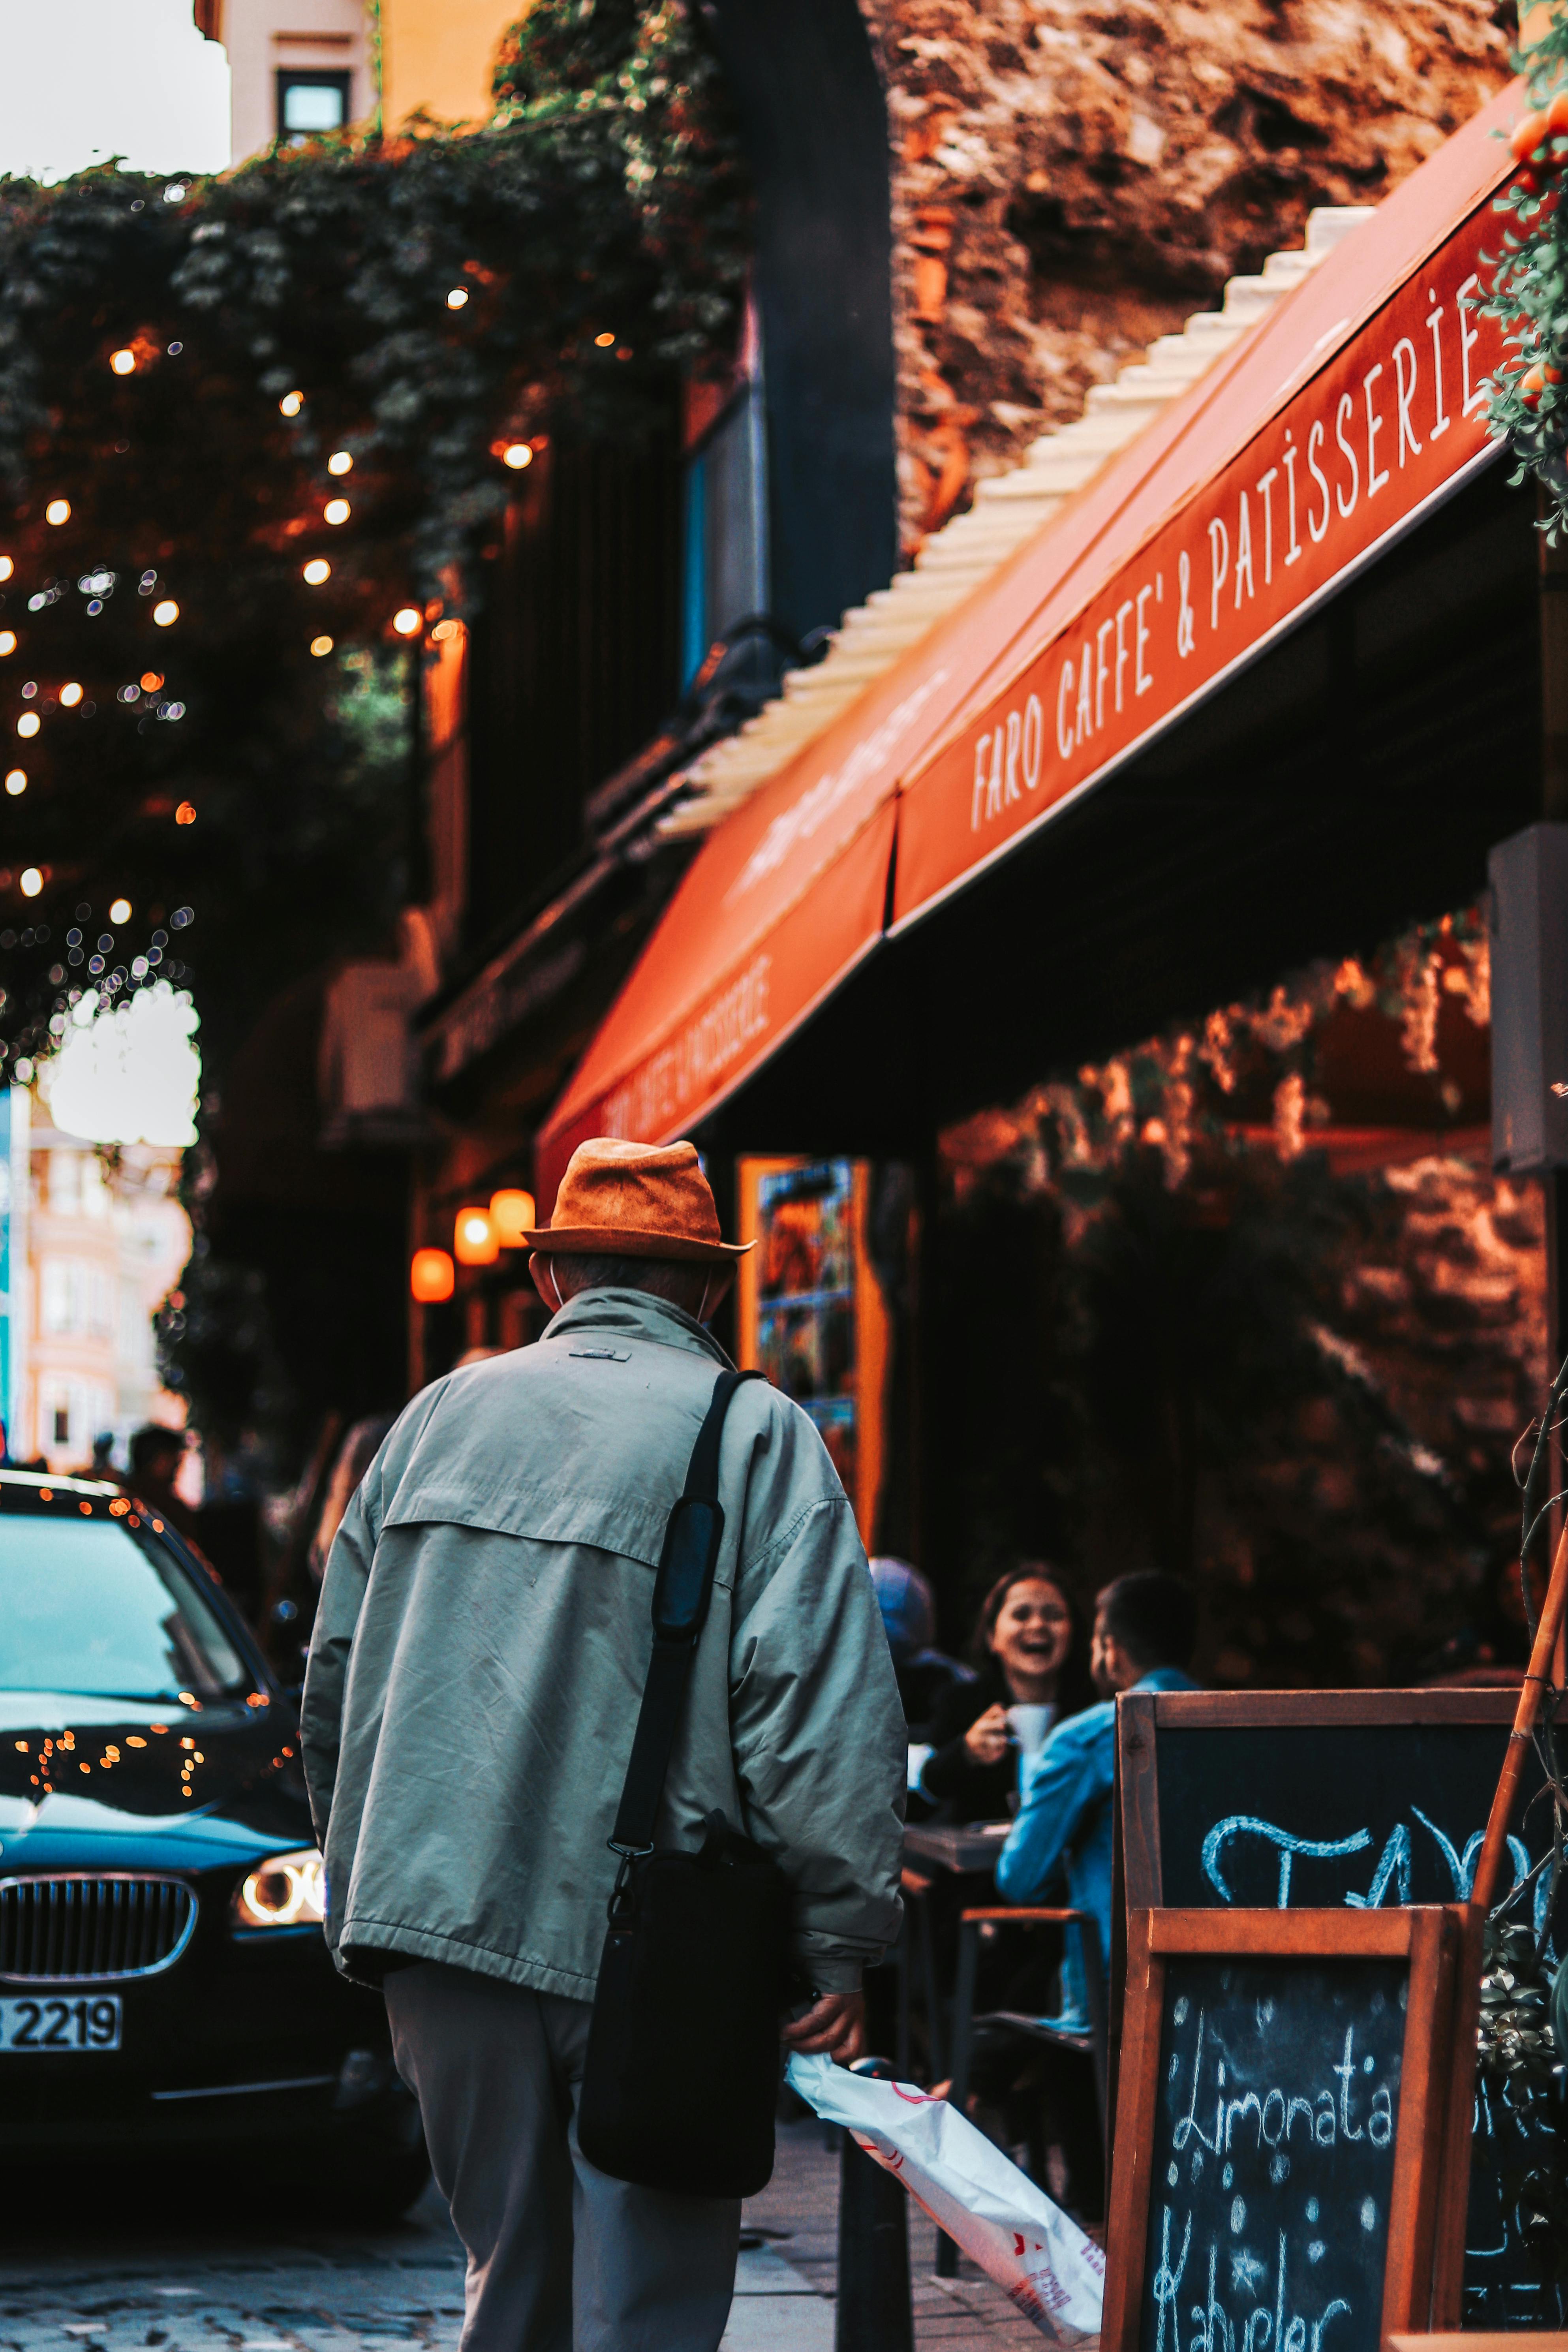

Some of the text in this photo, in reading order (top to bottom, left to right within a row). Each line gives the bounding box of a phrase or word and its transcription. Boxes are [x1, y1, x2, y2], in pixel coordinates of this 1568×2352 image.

[971, 694, 1043, 832] FARO
[1177, 550, 1195, 659] &
[11, 2000, 116, 2046] 2219
[1173, 2007, 1392, 2156] Limonata
